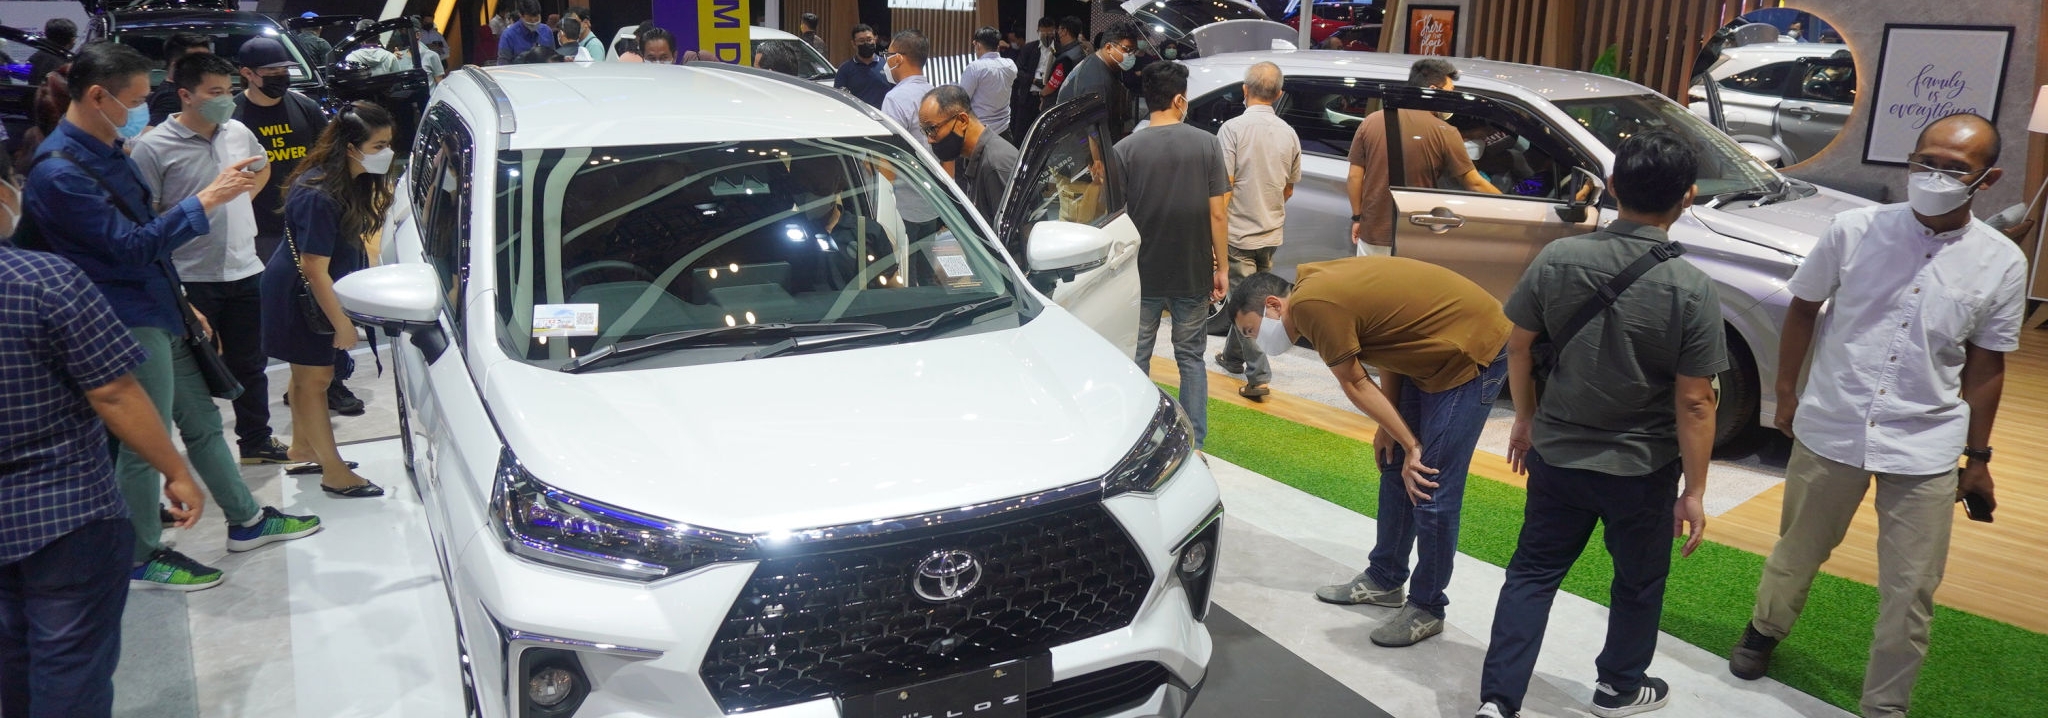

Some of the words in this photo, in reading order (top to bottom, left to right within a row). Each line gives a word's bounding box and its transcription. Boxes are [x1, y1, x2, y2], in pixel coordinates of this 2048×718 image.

[1908, 64, 1970, 98] family
[1928, 91, 1938, 103] is
[259, 124, 293, 136] WILL
[272, 137, 285, 148] IS
[266, 145, 307, 162] OWER
